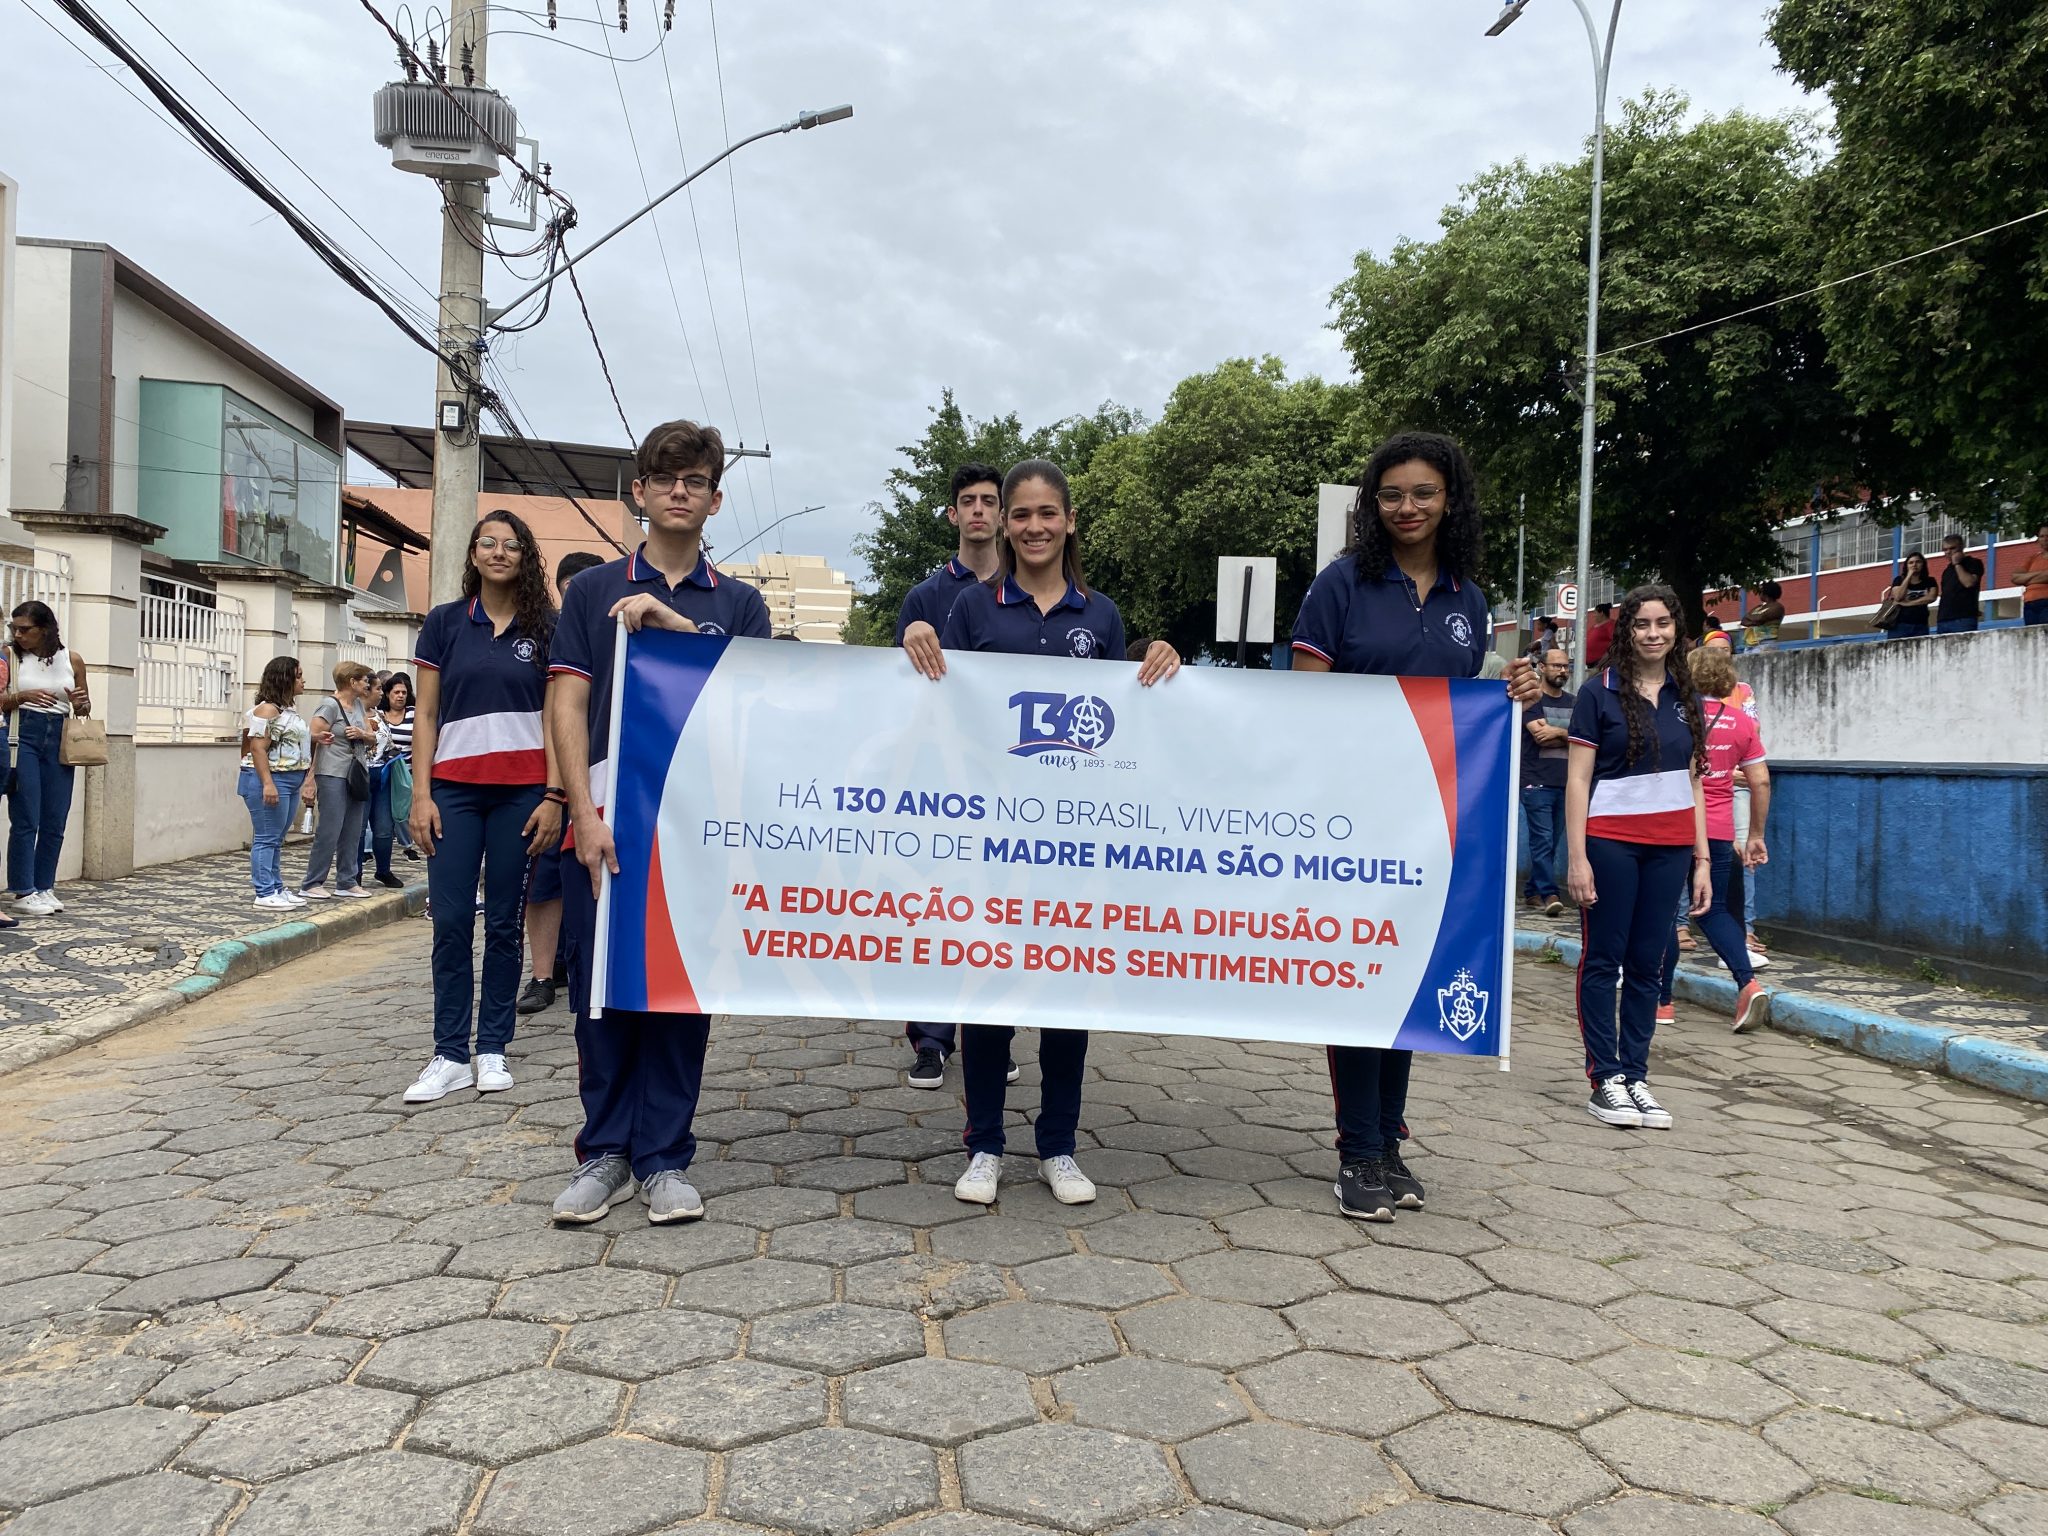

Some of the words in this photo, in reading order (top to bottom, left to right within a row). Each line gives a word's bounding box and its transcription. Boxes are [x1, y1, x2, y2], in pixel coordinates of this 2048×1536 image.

[1566, 591, 1576, 605] E
[1009, 691, 1115, 749] 130
[1039, 753, 1079, 771] anos
[1083, 758, 1105, 768] 1893
[1113, 760, 1137, 770] 2023
[778, 778, 822, 810] HÁ
[833, 786, 886, 813] 130
[894, 790, 986, 820] ANOS
[996, 796, 1045, 823] NO
[1056, 799, 1167, 835] BRASIL,
[1178, 806, 1316, 839] VIVEMOS
[1326, 814, 1353, 841] O
[703, 820, 921, 857] PENSAMENTO
[932, 833, 973, 861] DE
[983, 837, 1096, 868] MADRE
[1104, 843, 1207, 874] MARIA
[1216, 844, 1284, 878] SÃO
[1293, 854, 1423, 886] MIGUEL:
[780, 886, 975, 927] EDUCAÇÃO
[984, 897, 1023, 925] SE
[1032, 900, 1093, 929] FAZ
[1102, 903, 1184, 934] PELA
[1193, 907, 1341, 943] DIFUSÃO
[1352, 917, 1400, 947] DA
[742, 928, 903, 964] VERDADE
[912, 937, 932, 965] E
[940, 938, 1013, 970] DOS
[1023, 944, 1117, 975] BONS
